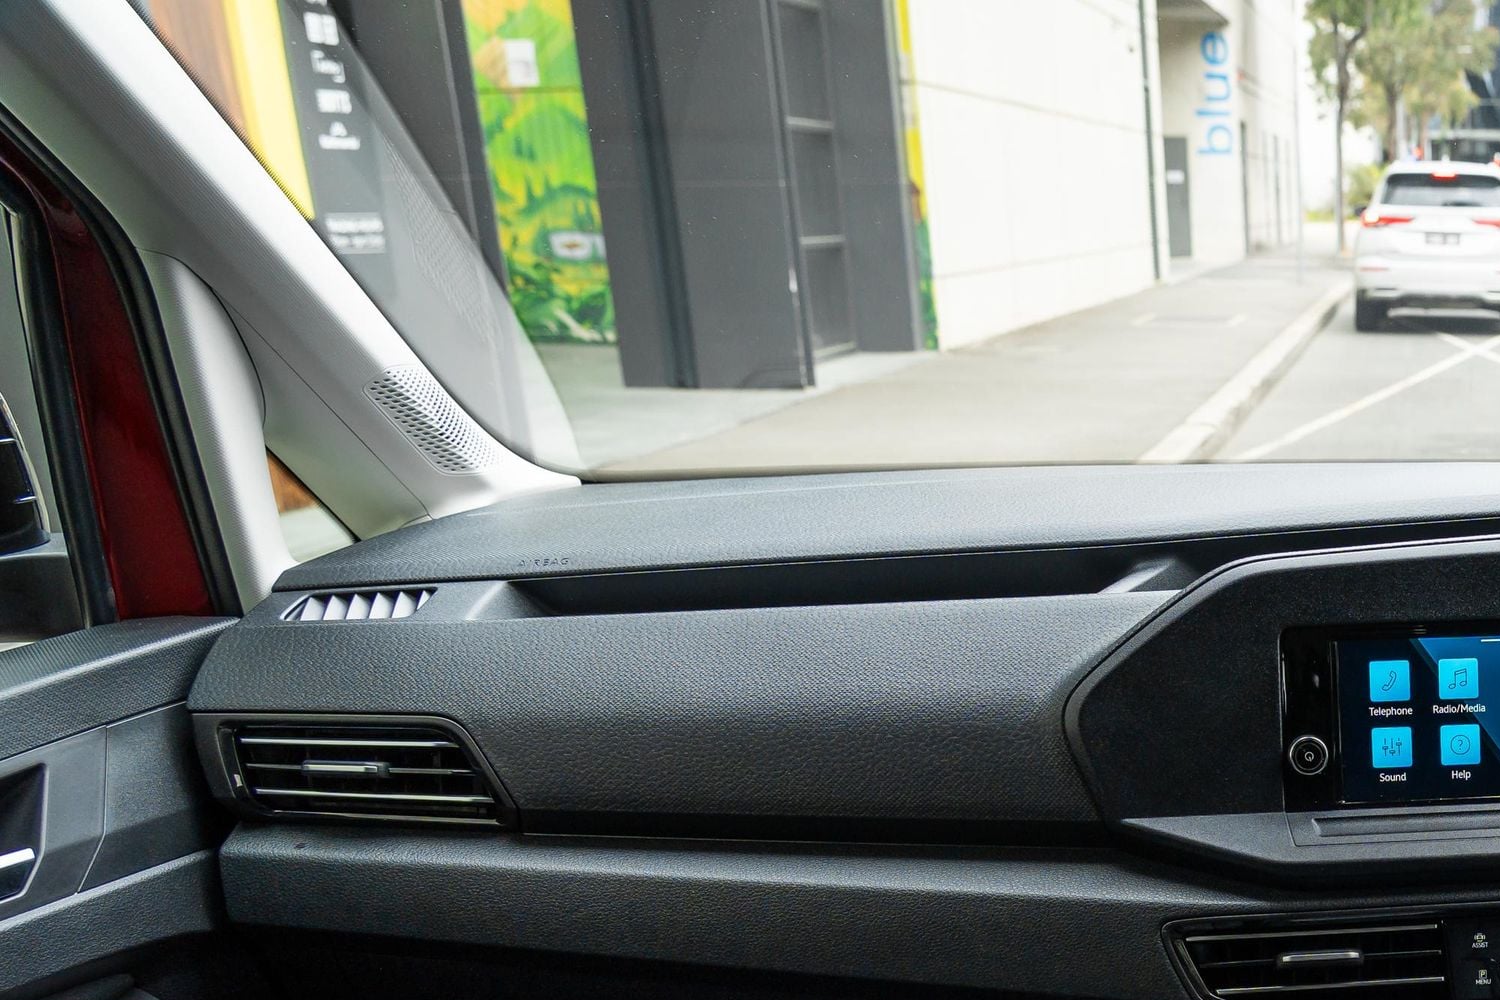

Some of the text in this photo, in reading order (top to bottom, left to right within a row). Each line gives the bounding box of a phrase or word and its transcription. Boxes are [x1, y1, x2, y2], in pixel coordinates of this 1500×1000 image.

[1195, 31, 1231, 155] blue
[1369, 706, 1413, 717] Telephone
[1433, 703, 1486, 714] Radio/Media
[1380, 772, 1407, 782] Sound
[1451, 770, 1472, 780] Help
